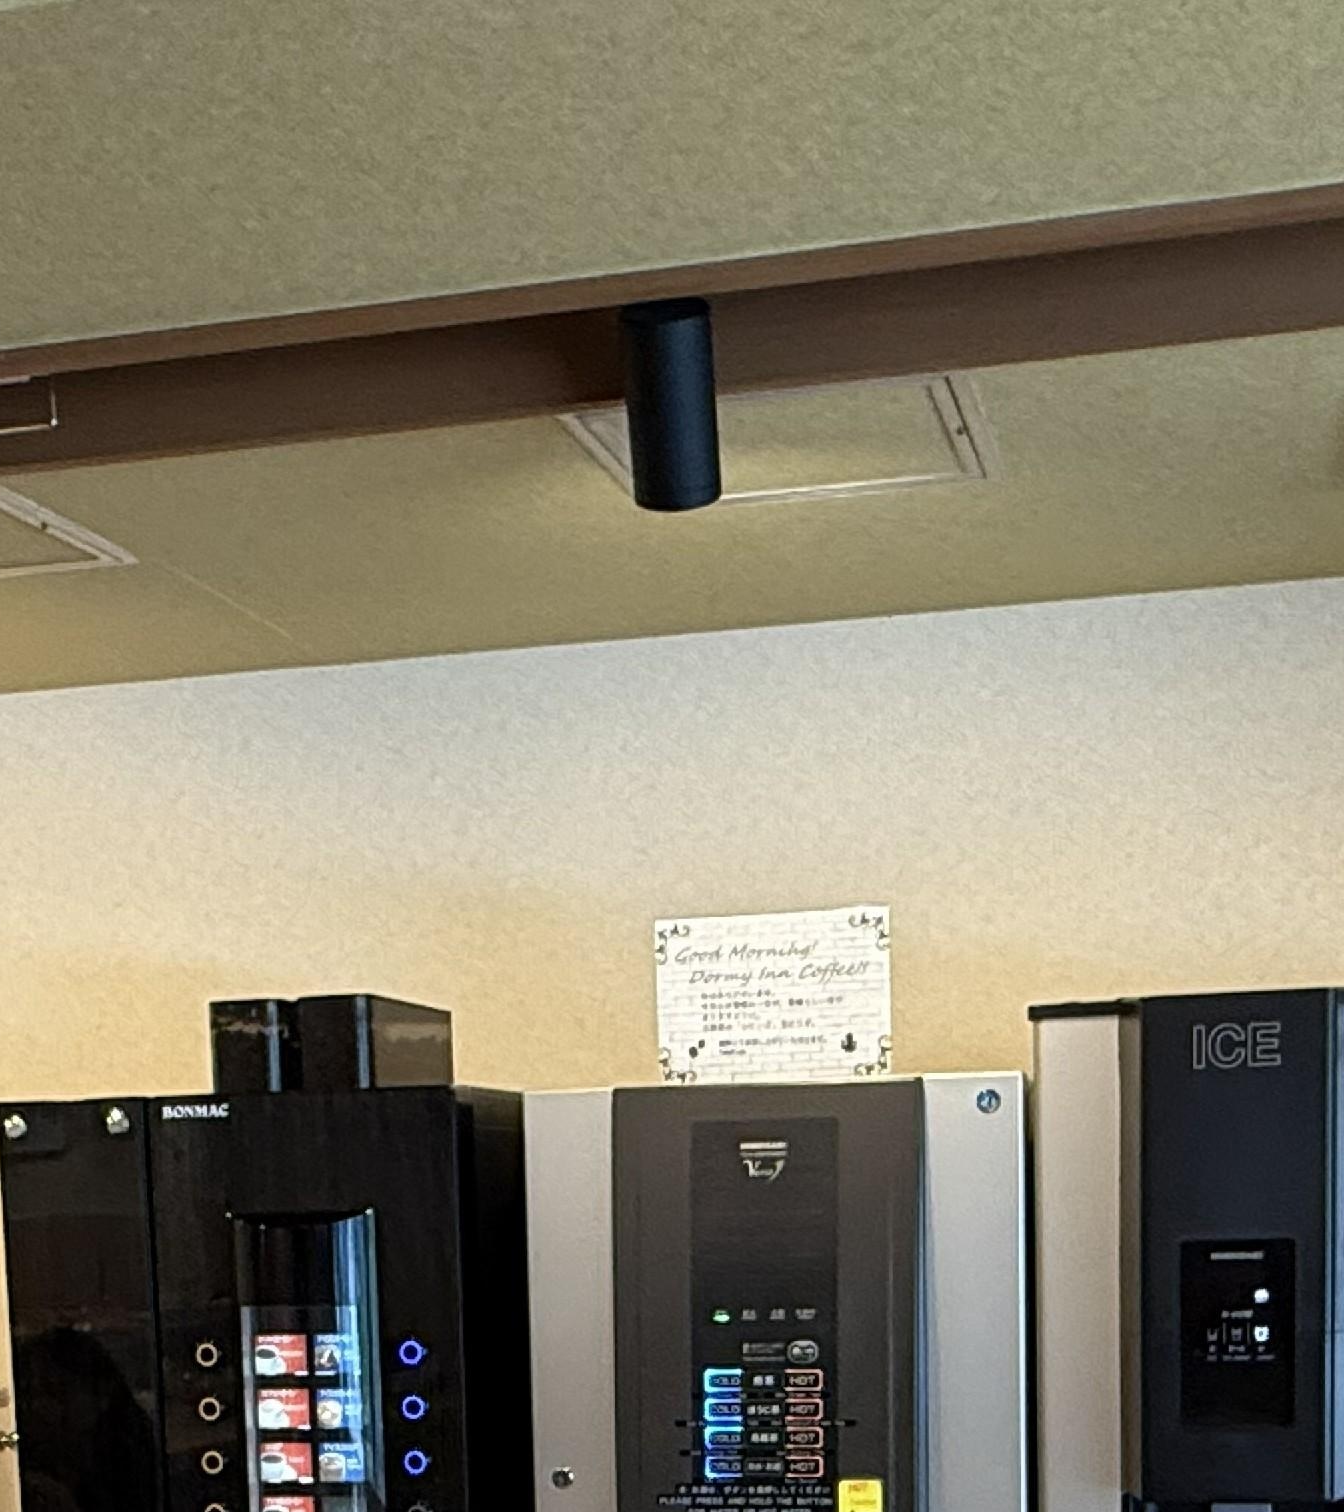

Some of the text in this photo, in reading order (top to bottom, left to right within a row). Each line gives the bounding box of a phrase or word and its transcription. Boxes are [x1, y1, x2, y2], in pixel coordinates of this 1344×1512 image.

[674, 945, 723, 965] Good
[689, 968, 753, 986] Dormy
[759, 967, 792, 981] Inn
[1192, 1021, 1282, 1069] ICE
[161, 1102, 230, 1119] BONMAC
[788, 1376, 816, 1386] HOT
[788, 1404, 816, 1415] HOT
[788, 1432, 816, 1443] HOT
